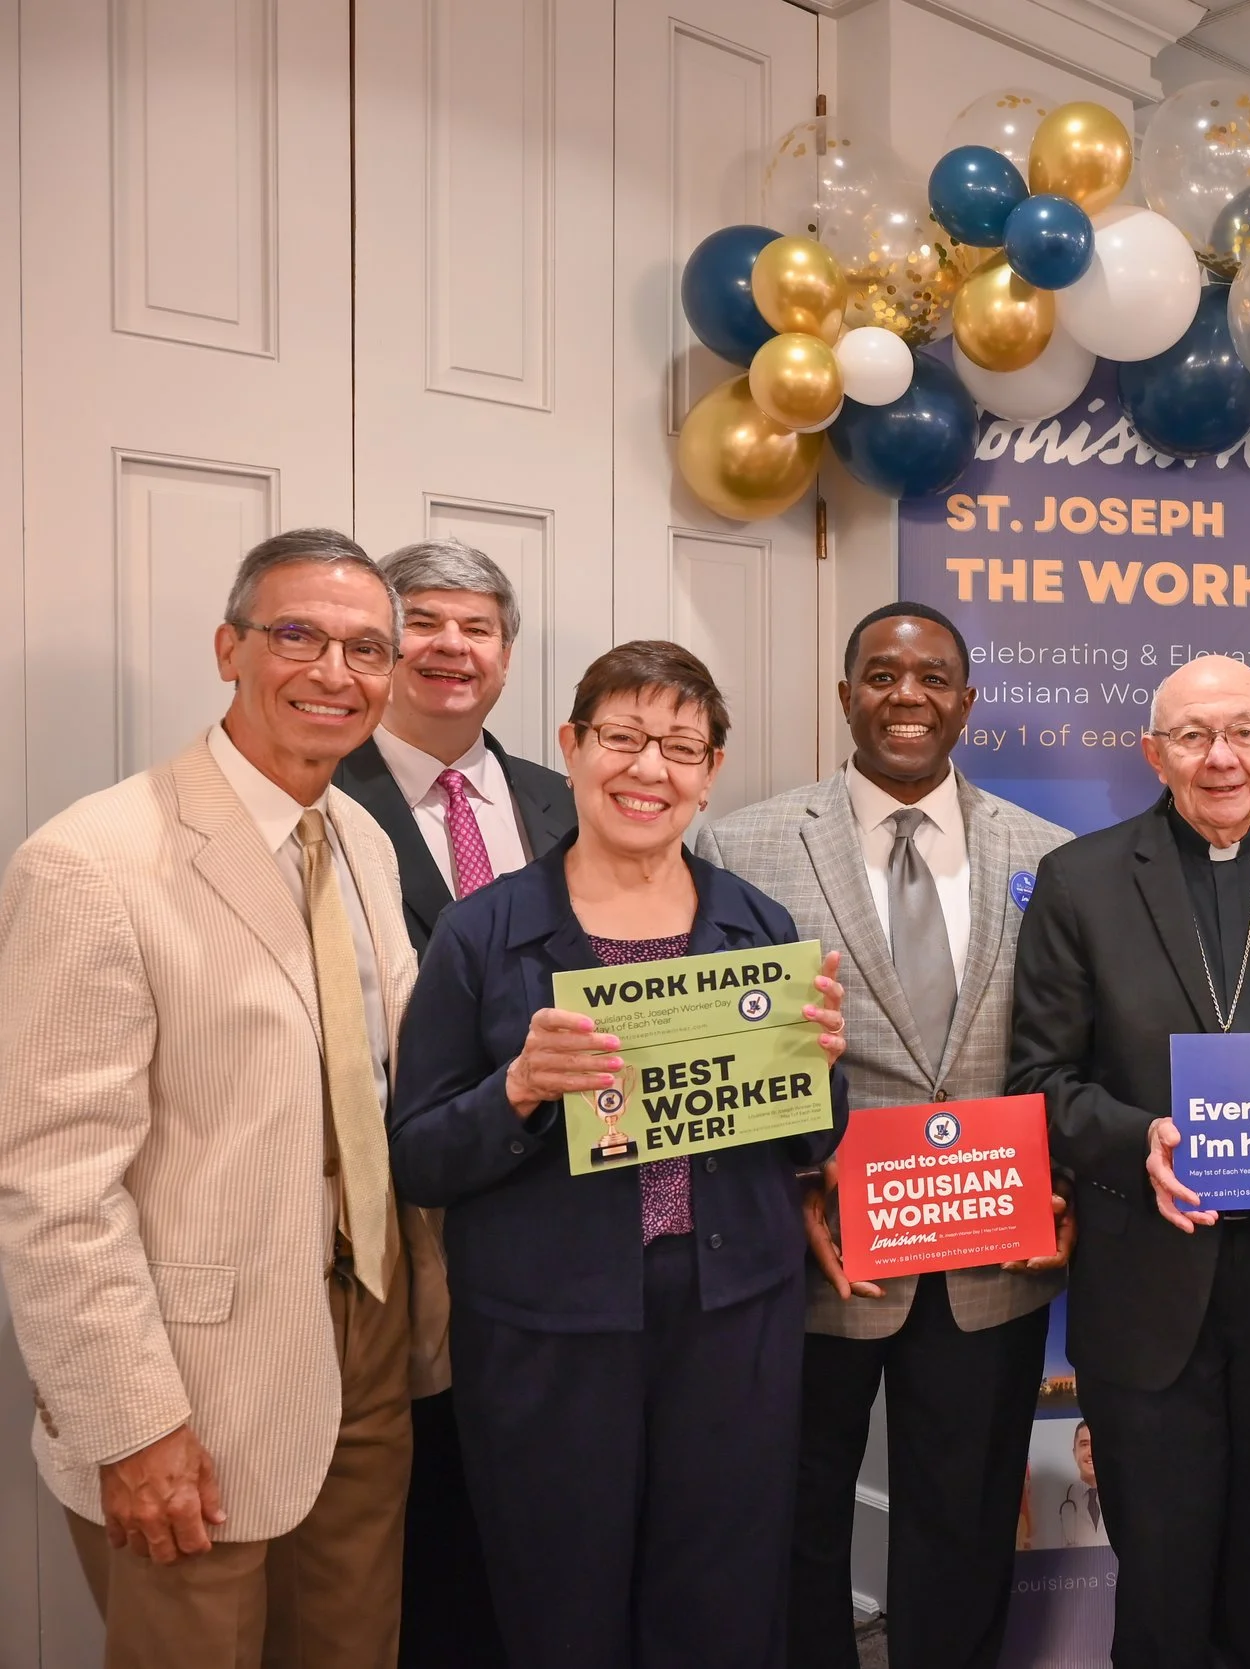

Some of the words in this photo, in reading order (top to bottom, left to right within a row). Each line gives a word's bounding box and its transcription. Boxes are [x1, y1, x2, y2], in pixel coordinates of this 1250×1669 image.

[946, 494, 1024, 533] ST.
[1034, 496, 1224, 538] JOSEPH
[946, 558, 1064, 602] THE
[970, 642, 1128, 671] elebrating
[1140, 644, 1158, 666] &
[1018, 725, 1026, 746] 1
[1040, 724, 1071, 746] of
[583, 974, 688, 1008] WORK
[697, 962, 791, 992] HARD.
[594, 1013, 632, 1026] ouisiana
[647, 1006, 679, 1018] Joseph
[680, 1001, 712, 1013] Worker
[714, 999, 732, 1009] Day
[616, 1022, 626, 1032] of
[628, 1020, 650, 1030] Each
[651, 1017, 672, 1028] Year
[641, 1054, 736, 1094] BEST
[642, 1072, 812, 1123] WORKER
[646, 1114, 736, 1150] EVER!
[866, 1155, 916, 1176] proud
[918, 1153, 936, 1168] to
[938, 1146, 1016, 1165] celebrate
[867, 1167, 1023, 1205] LOUISIANA
[867, 1194, 1014, 1231] WORKERS
[870, 1231, 938, 1251] Louisiana
[875, 1241, 1020, 1264] www.saintjosephtheworker.com
[1010, 1574, 1098, 1594] ouisiana
